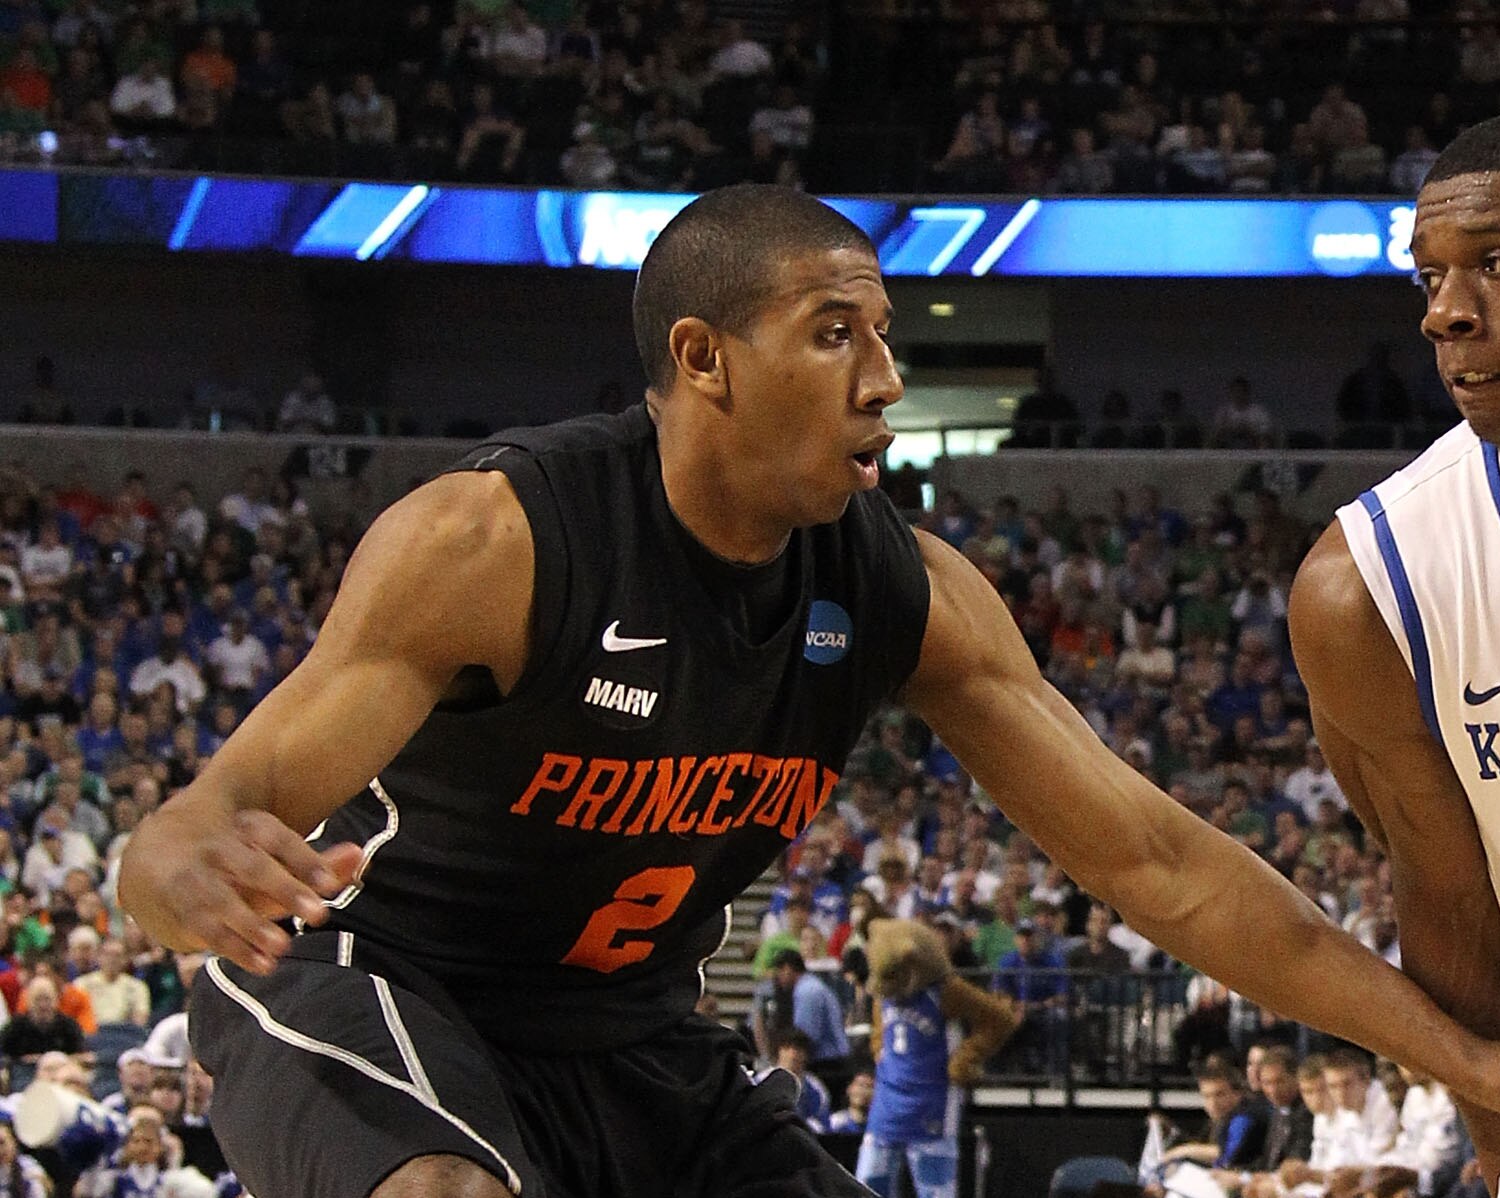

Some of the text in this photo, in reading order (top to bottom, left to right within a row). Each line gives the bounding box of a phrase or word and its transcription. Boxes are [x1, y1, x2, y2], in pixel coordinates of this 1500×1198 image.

[584, 677, 658, 718] MARV
[510, 752, 839, 840] PRINCETON
[560, 865, 696, 974] 2
